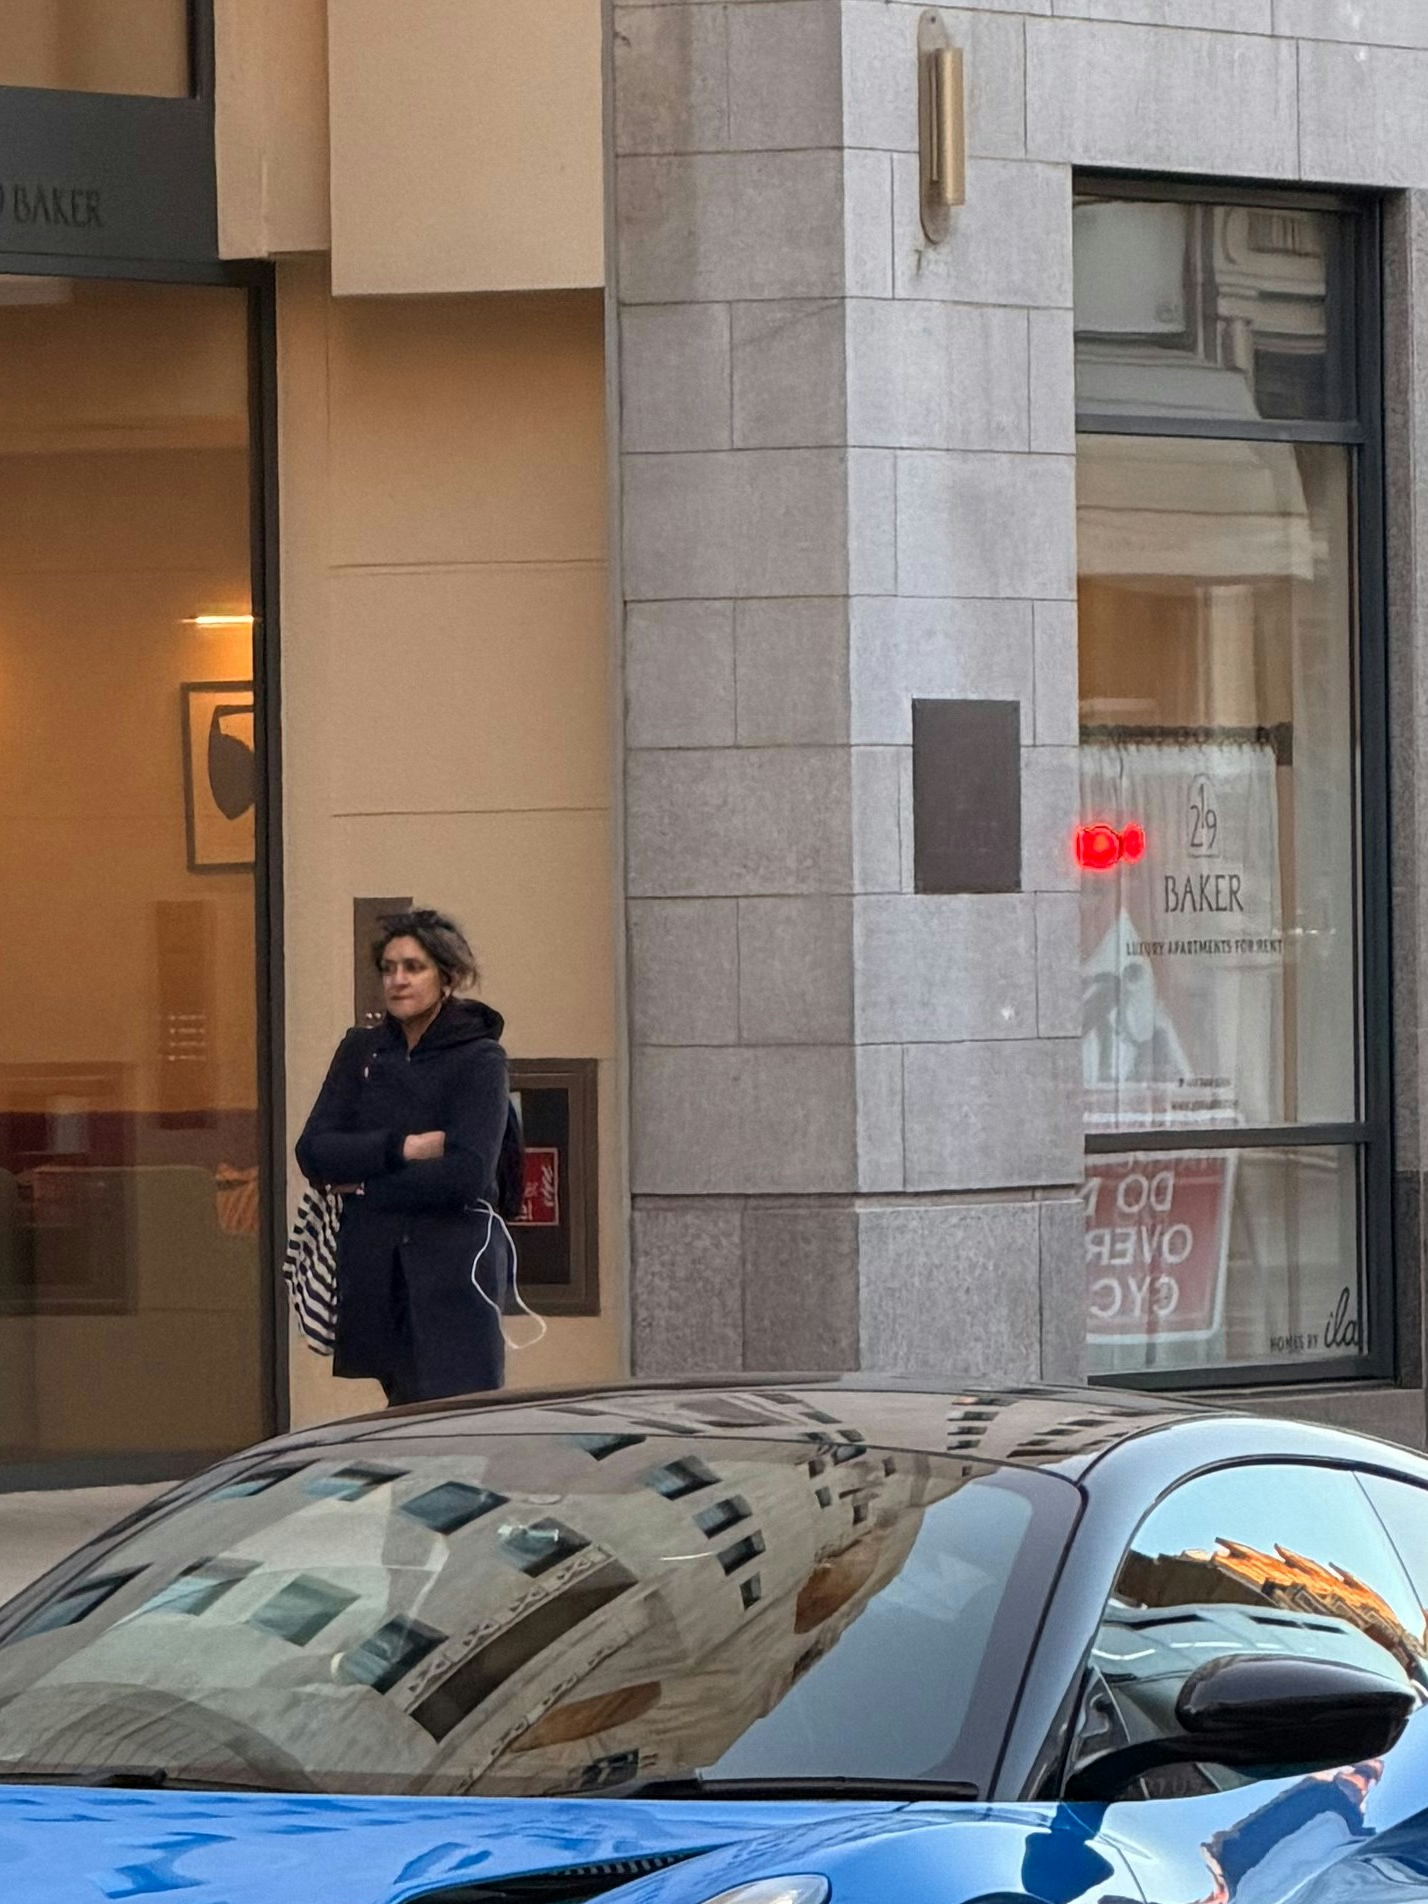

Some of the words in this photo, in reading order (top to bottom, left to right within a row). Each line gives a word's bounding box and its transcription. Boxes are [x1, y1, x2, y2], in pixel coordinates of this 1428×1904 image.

[13, 184, 104, 228] BAKER
[1164, 873, 1244, 913] BAKER
[1126, 941, 1165, 957] LUXURY
[1167, 940, 1233, 955] APARTMENTS
[1235, 939, 1255, 954] FOR
[1256, 938, 1283, 954] RENT
